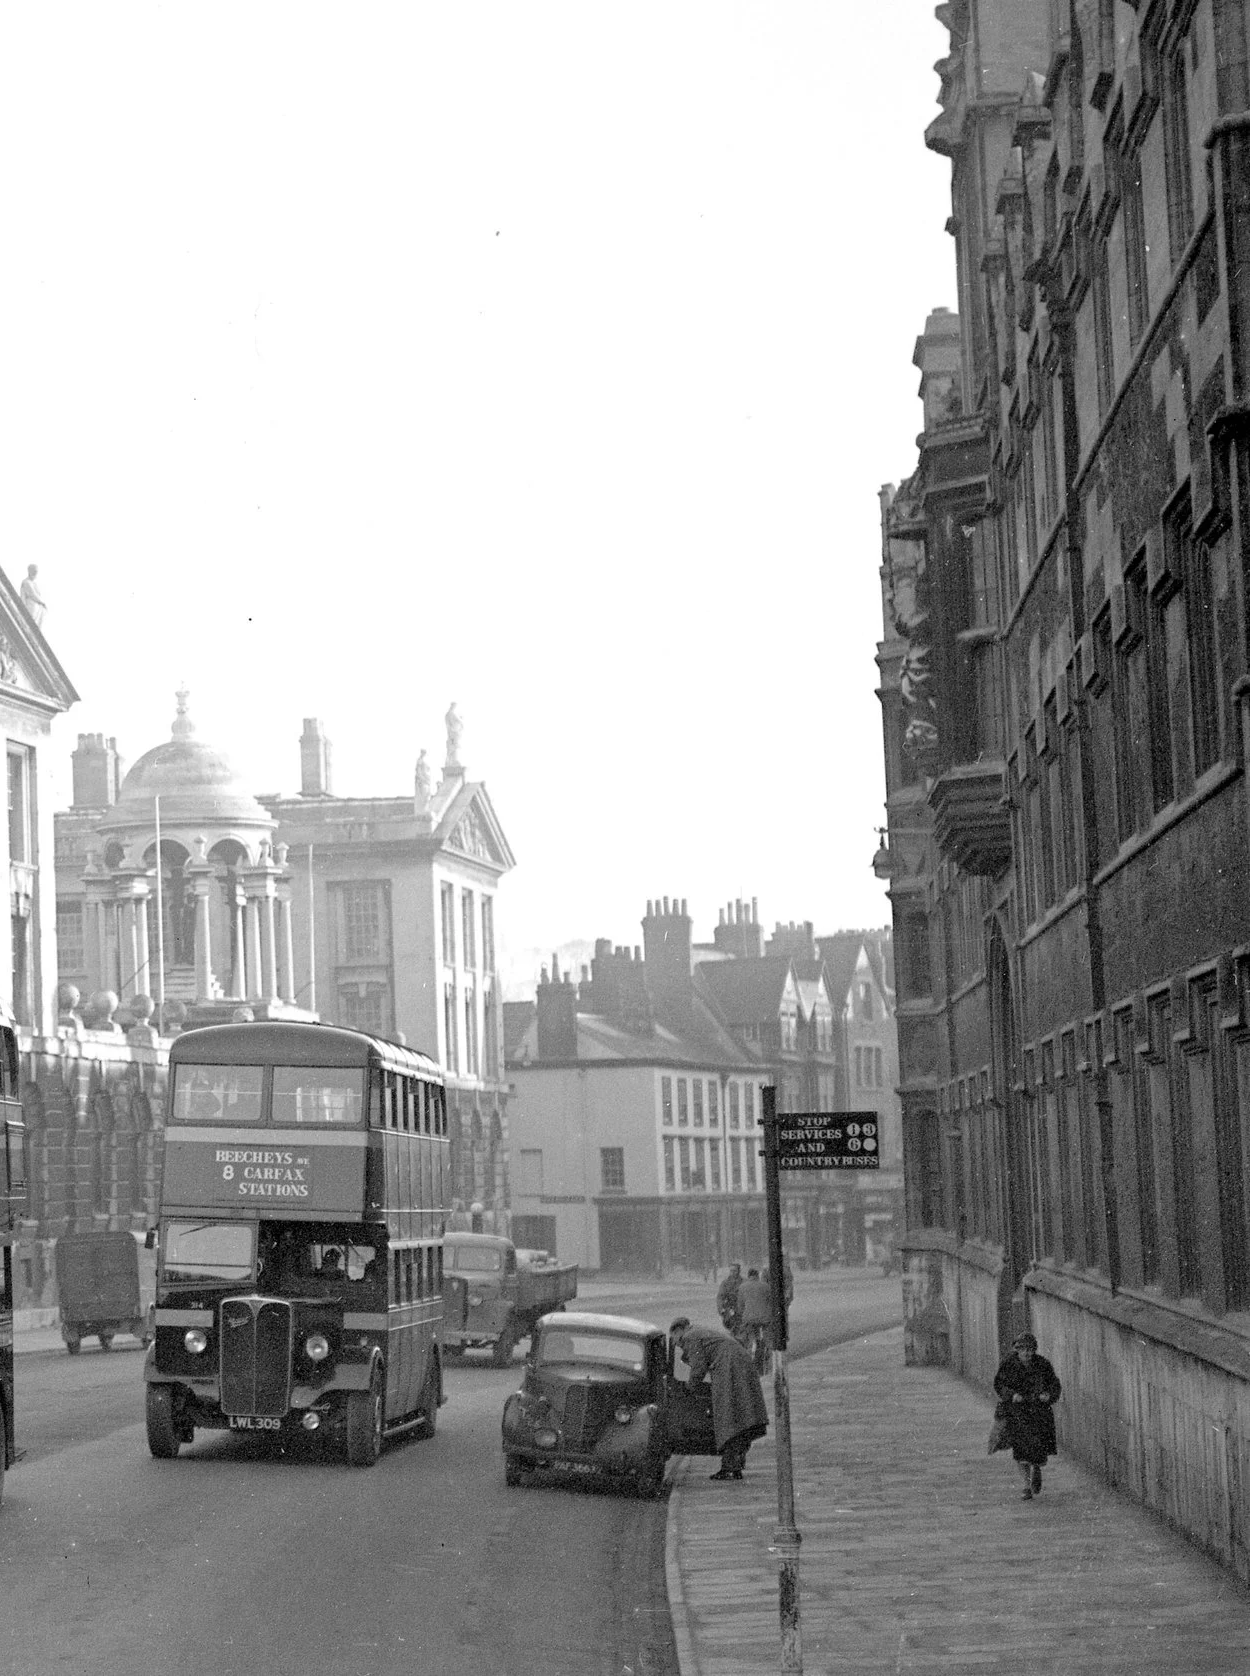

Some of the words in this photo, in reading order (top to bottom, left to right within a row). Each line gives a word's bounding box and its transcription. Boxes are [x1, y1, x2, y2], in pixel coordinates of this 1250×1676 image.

[797, 1117, 830, 1126] STOP
[781, 1129, 842, 1139] SERVICES
[797, 1143, 825, 1152] AND
[216, 1150, 293, 1164] BEECHEYS
[781, 1156, 841, 1166] COUNTRY
[842, 1155, 878, 1165] BUSES
[222, 1165, 234, 1180] 8
[244, 1167, 305, 1180] CARFAX
[238, 1182, 308, 1196] STATIONS
[230, 1416, 254, 1429] LWL
[255, 1417, 281, 1429] 309
